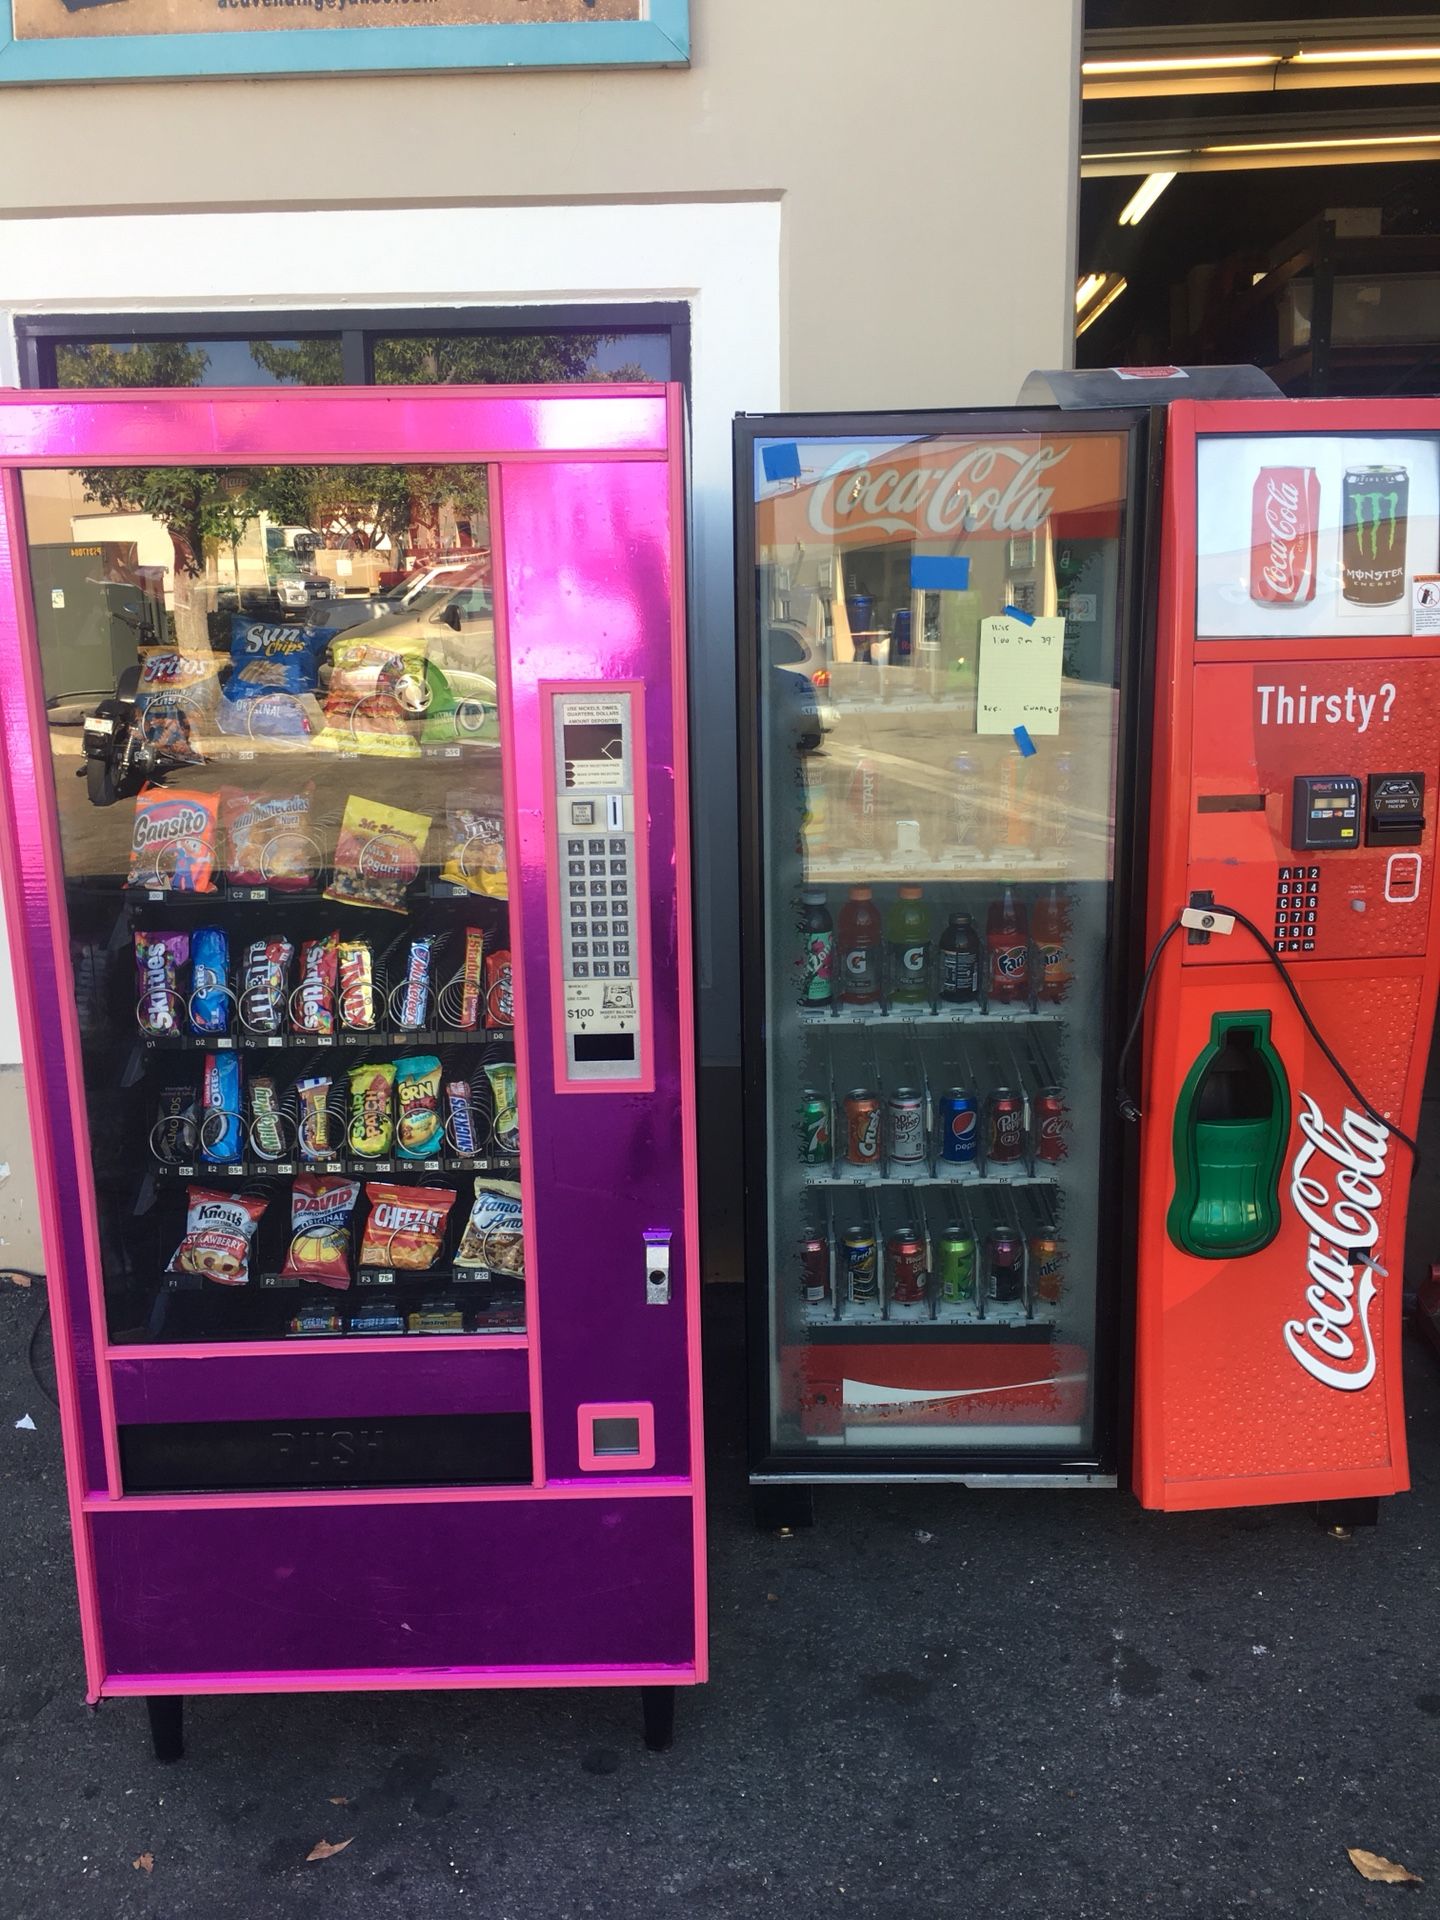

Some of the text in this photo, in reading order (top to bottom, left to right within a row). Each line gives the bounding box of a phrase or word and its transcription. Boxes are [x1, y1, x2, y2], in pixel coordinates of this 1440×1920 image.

[808, 445, 1072, 537] Coca-Cola
[1263, 478, 1299, 595] Coca-Cola
[1347, 567, 1404, 581] MONSTER
[246, 625, 301, 653] Sun
[265, 640, 306, 657] Chips
[144, 653, 209, 683] Fritos
[1256, 683, 1397, 732] Thirsty?
[133, 809, 207, 850] Gansito
[1282, 870, 1290, 880] A
[1298, 870, 1303, 878] 1
[1312, 868, 1318, 878] 2
[1282, 884, 1288, 894] B
[1296, 884, 1302, 894] 3
[1310, 883, 1317, 892] 4
[1280, 898, 1288, 908] C
[1295, 898, 1302, 908] 5
[1310, 898, 1316, 908] 6
[1280, 914, 1286, 923] D
[1294, 912, 1300, 922] 7
[1308, 912, 1314, 922] 8
[1279, 928, 1285, 937] E
[1293, 927, 1300, 936] 9
[1307, 926, 1314, 936] 0
[1278, 942, 1284, 952] F
[1304, 942, 1314, 950] CLR
[846, 950, 868, 974] G
[903, 946, 925, 971] G
[147, 942, 174, 1030] Skittles
[303, 947, 324, 1029] Skittles
[339, 951, 368, 1027] TWIX
[567, 1008, 595, 1019] $1.00
[211, 1067, 224, 1107] OREO
[352, 1094, 366, 1138] SOUR
[365, 1090, 381, 1138] PATCH
[451, 1096, 474, 1153] SNICKERS
[293, 1189, 353, 1214] DAVID
[198, 1204, 243, 1227] Knott's
[301, 1212, 345, 1229] ORIGINAL
[374, 1203, 443, 1234] CHEEZ-IT
[1283, 1090, 1390, 1391] Coca-Cola
